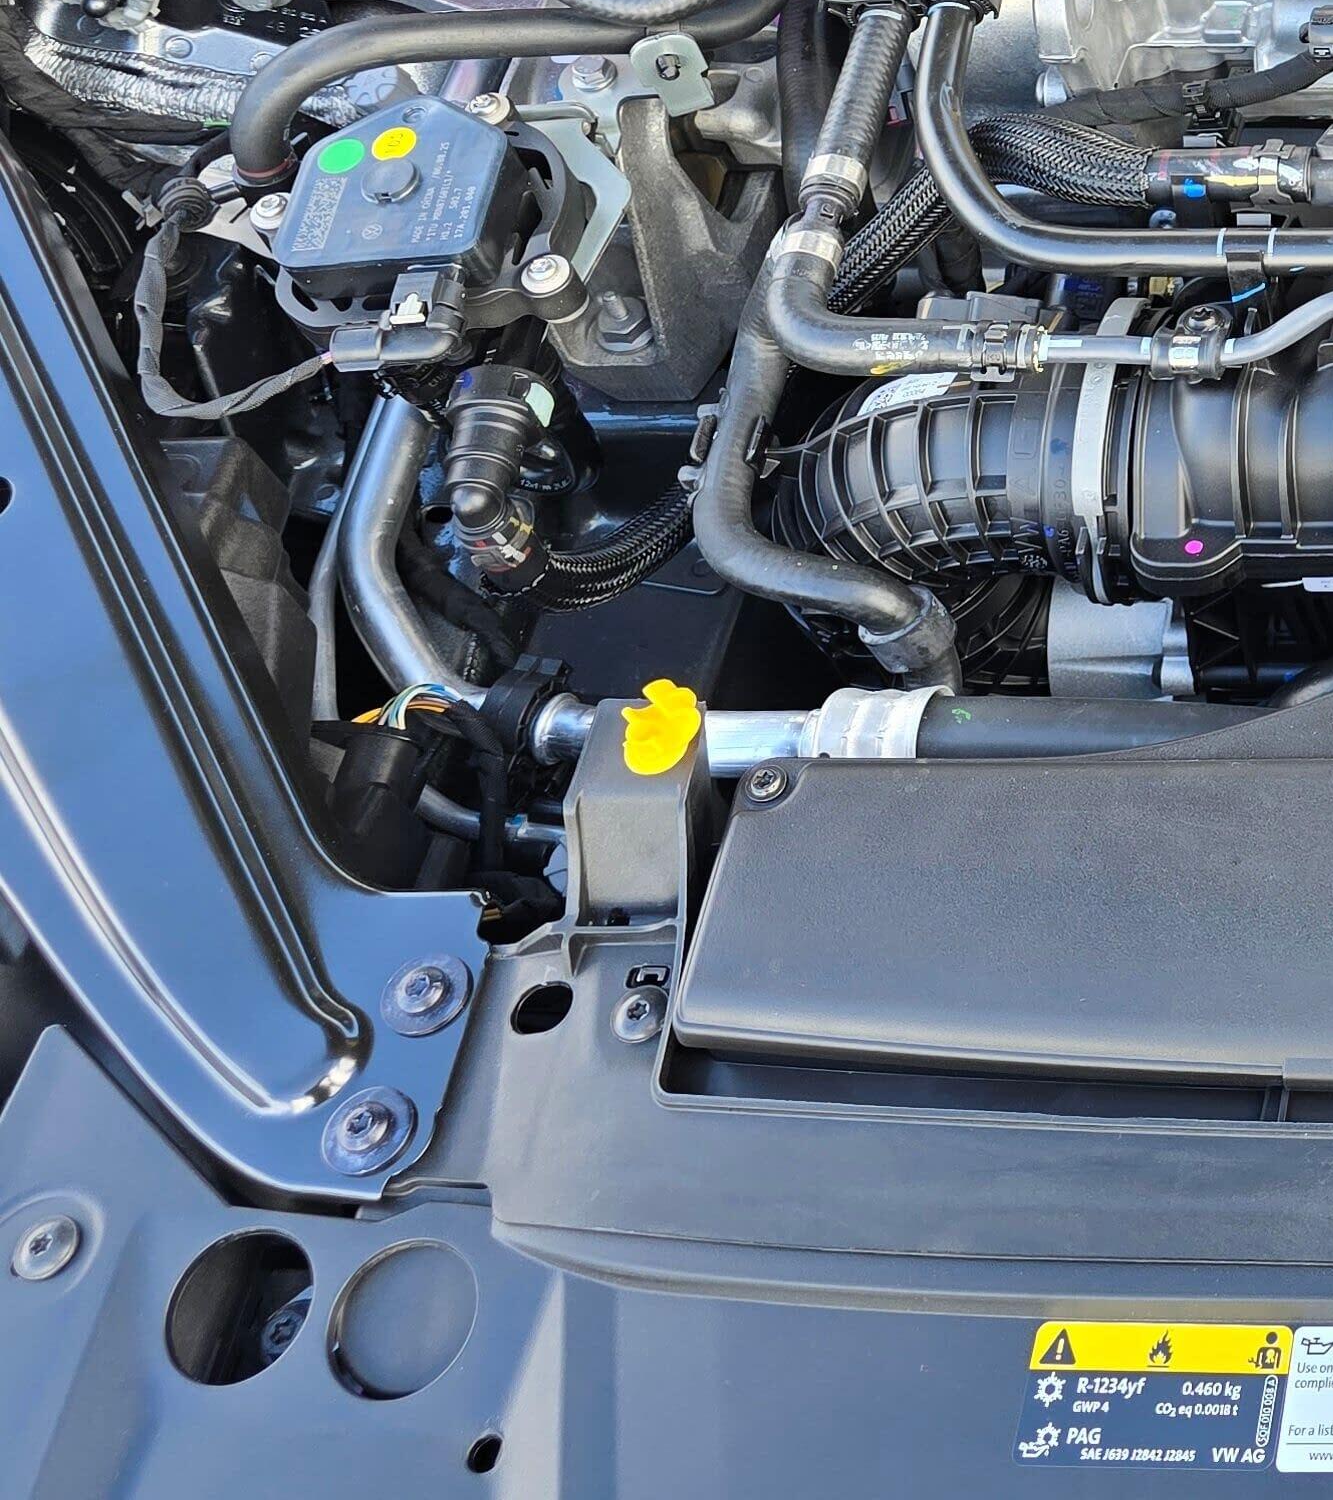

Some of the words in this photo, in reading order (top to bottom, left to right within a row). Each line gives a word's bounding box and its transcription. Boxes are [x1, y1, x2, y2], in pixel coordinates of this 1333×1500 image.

[1297, 1362, 1317, 1373] Use
[1076, 1377, 1147, 1399] R-1234yf
[1182, 1381, 1223, 1396] 0.460
[1225, 1381, 1241, 1400] kg
[1073, 1401, 1100, 1413] GWP
[1100, 1401, 1110, 1413] 4
[1178, 1404, 1194, 1418] eq
[1195, 1403, 1232, 1416] 0.0018
[1232, 1404, 1238, 1416] t
[1066, 1427, 1101, 1445] PAG
[1288, 1425, 1306, 1436] For
[1308, 1428, 1314, 1436] a
[1080, 1448, 1102, 1461] SAE
[1103, 1448, 1128, 1461] J639
[1130, 1449, 1162, 1462] J2842
[1163, 1449, 1196, 1462] J2845
[1212, 1448, 1240, 1463] VW
[1241, 1448, 1266, 1463] AG
